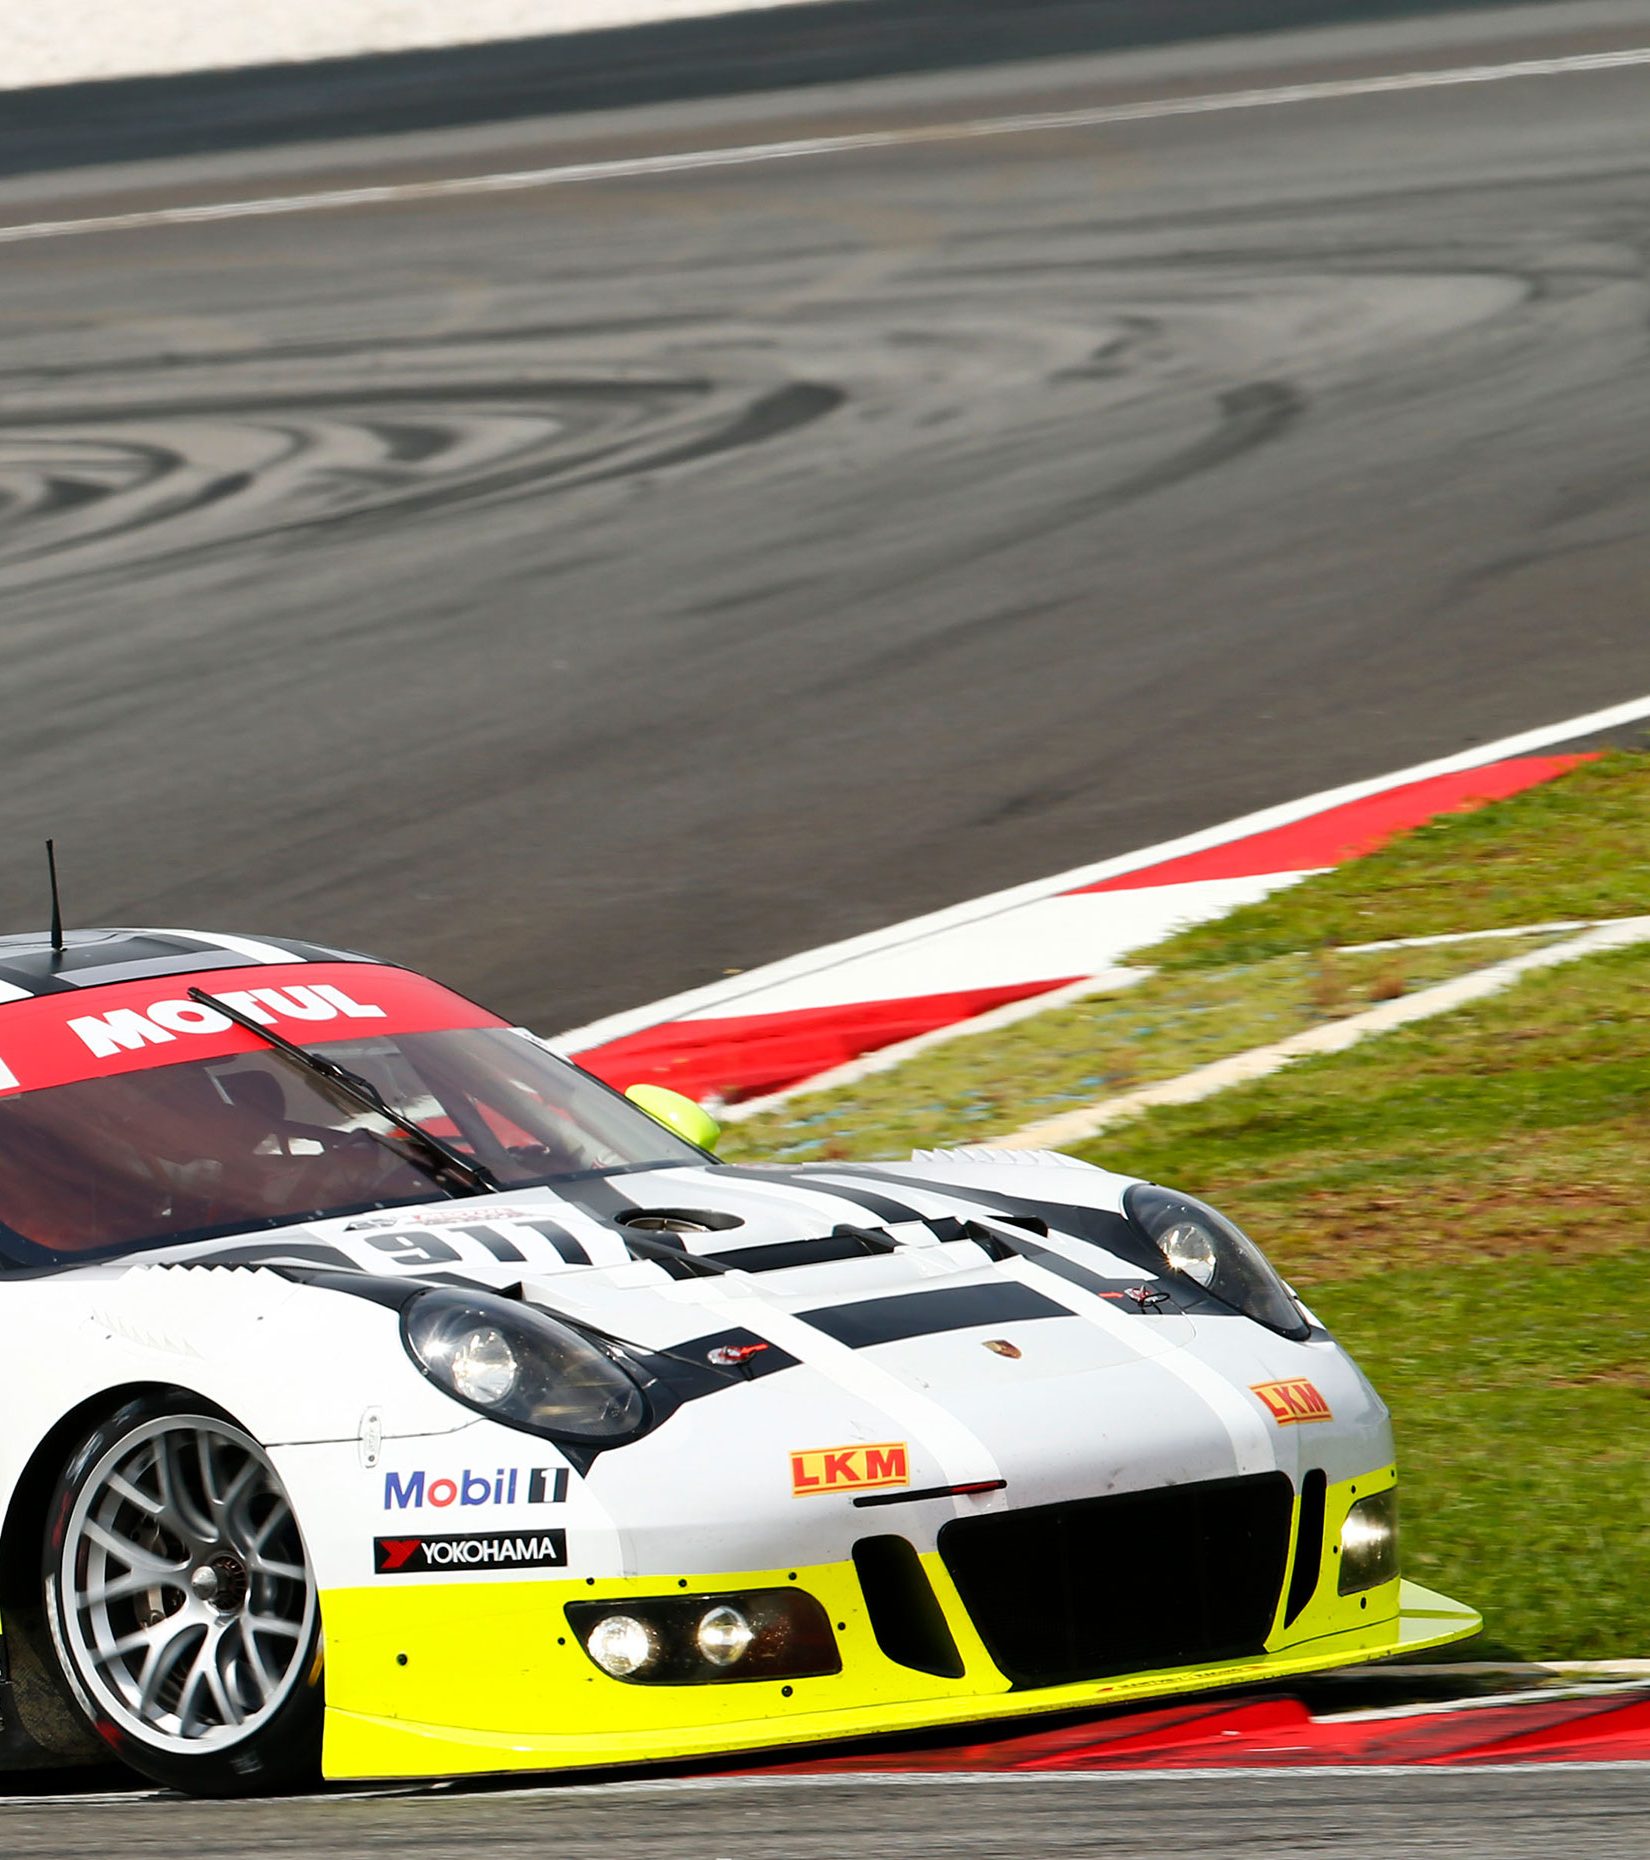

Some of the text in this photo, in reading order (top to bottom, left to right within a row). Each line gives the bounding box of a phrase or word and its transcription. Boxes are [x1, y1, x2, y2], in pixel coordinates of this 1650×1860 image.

[65, 984, 387, 1058] MOTUL
[364, 1220, 593, 1266] 911
[1254, 1383, 1329, 1417] LKM
[792, 1448, 906, 1488] LKM
[384, 1468, 518, 1509] Mobil
[421, 1537, 557, 1564] YOKOHAMA
